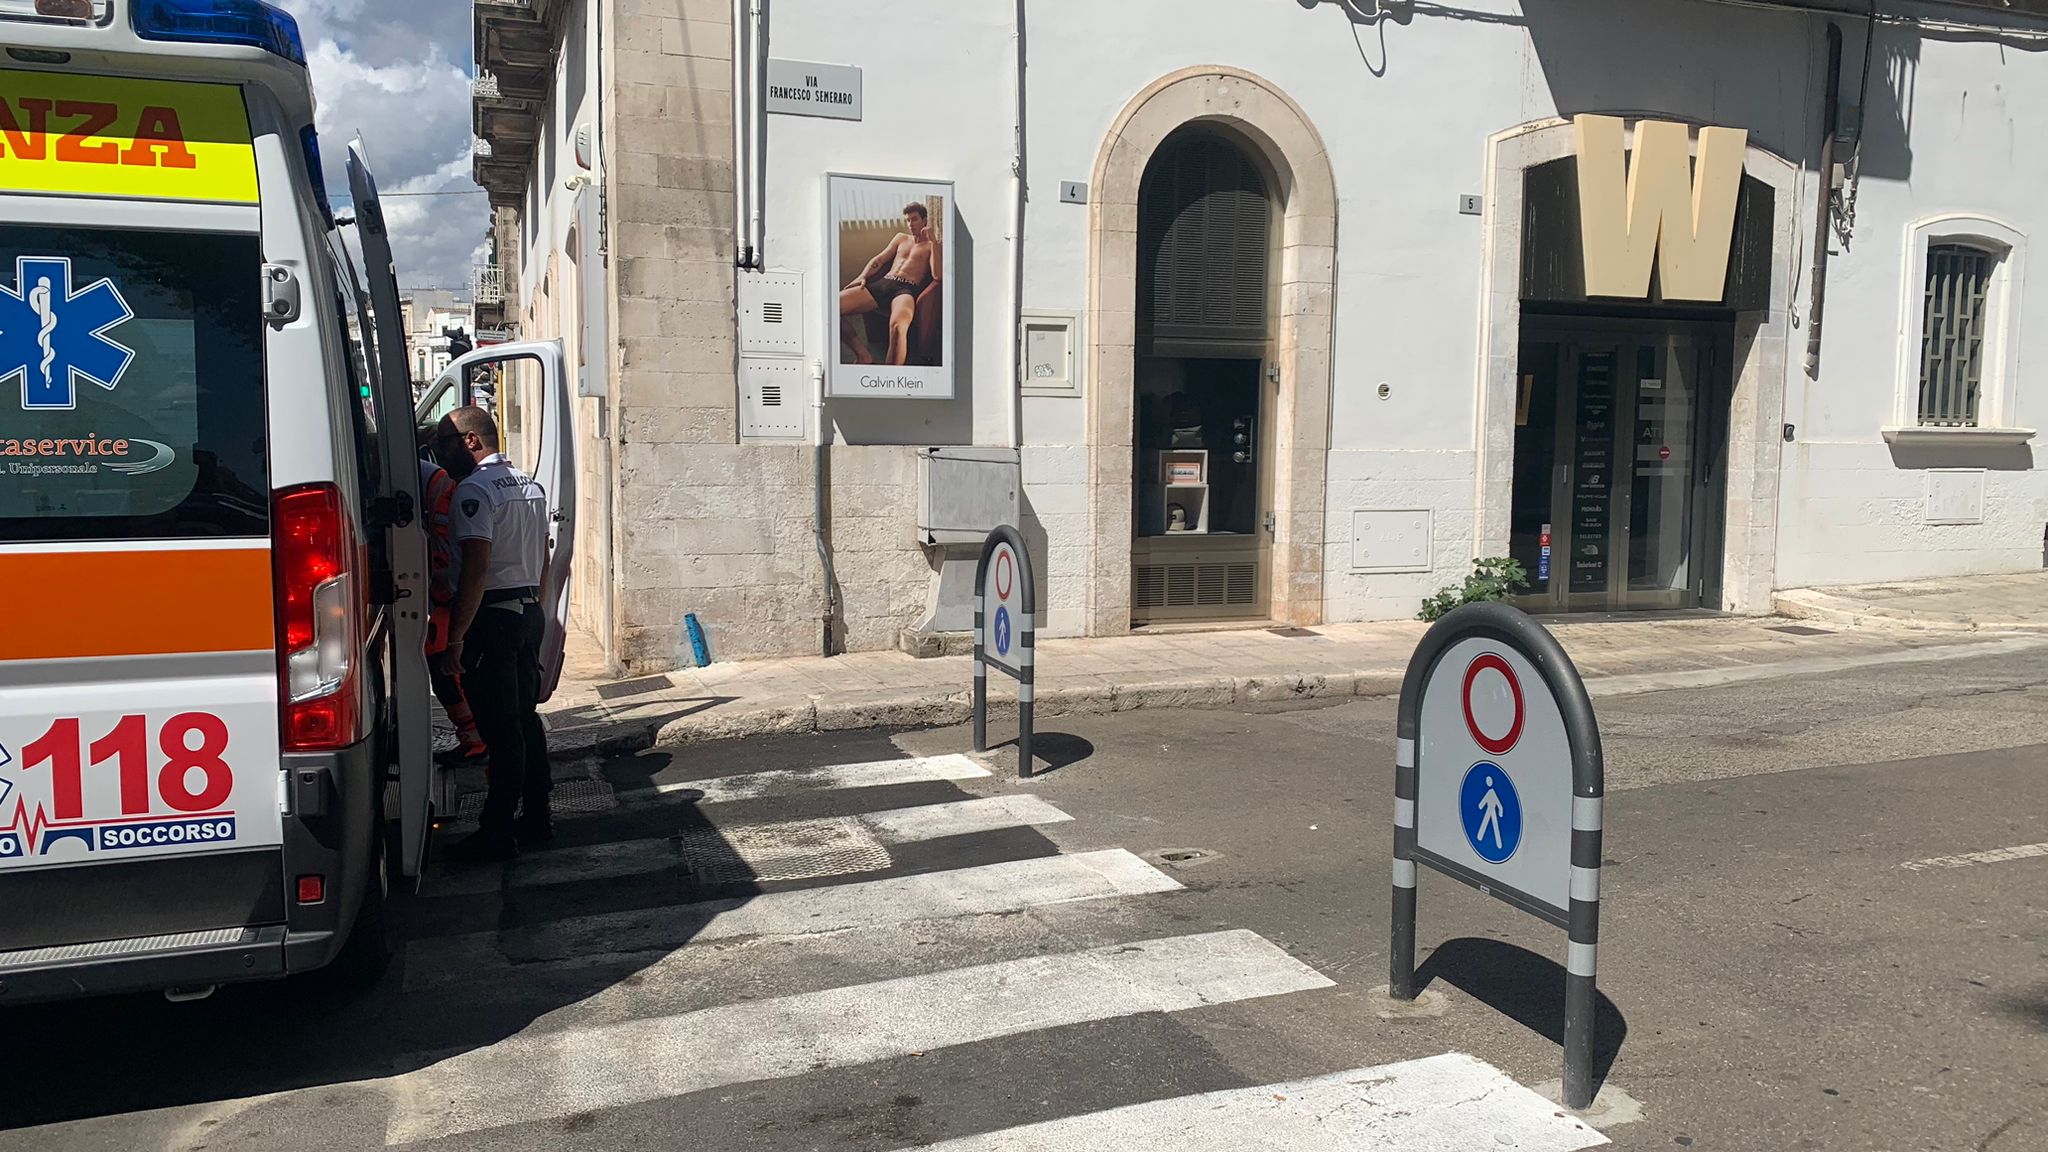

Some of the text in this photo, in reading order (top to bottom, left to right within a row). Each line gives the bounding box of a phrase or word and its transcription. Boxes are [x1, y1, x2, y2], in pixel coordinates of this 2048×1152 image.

[805, 75, 818, 87] VIA
[770, 86, 853, 105] FRANCESCO SEMERARO
[1069, 185, 1076, 199] 4
[1468, 197, 1475, 210] 5
[1574, 113, 1748, 302] W
[860, 375, 924, 389] Calvin Klein
[9, 462, 98, 477] Unipersonale
[21, 711, 234, 820] 118
[104, 821, 232, 847] SOCCORSO
